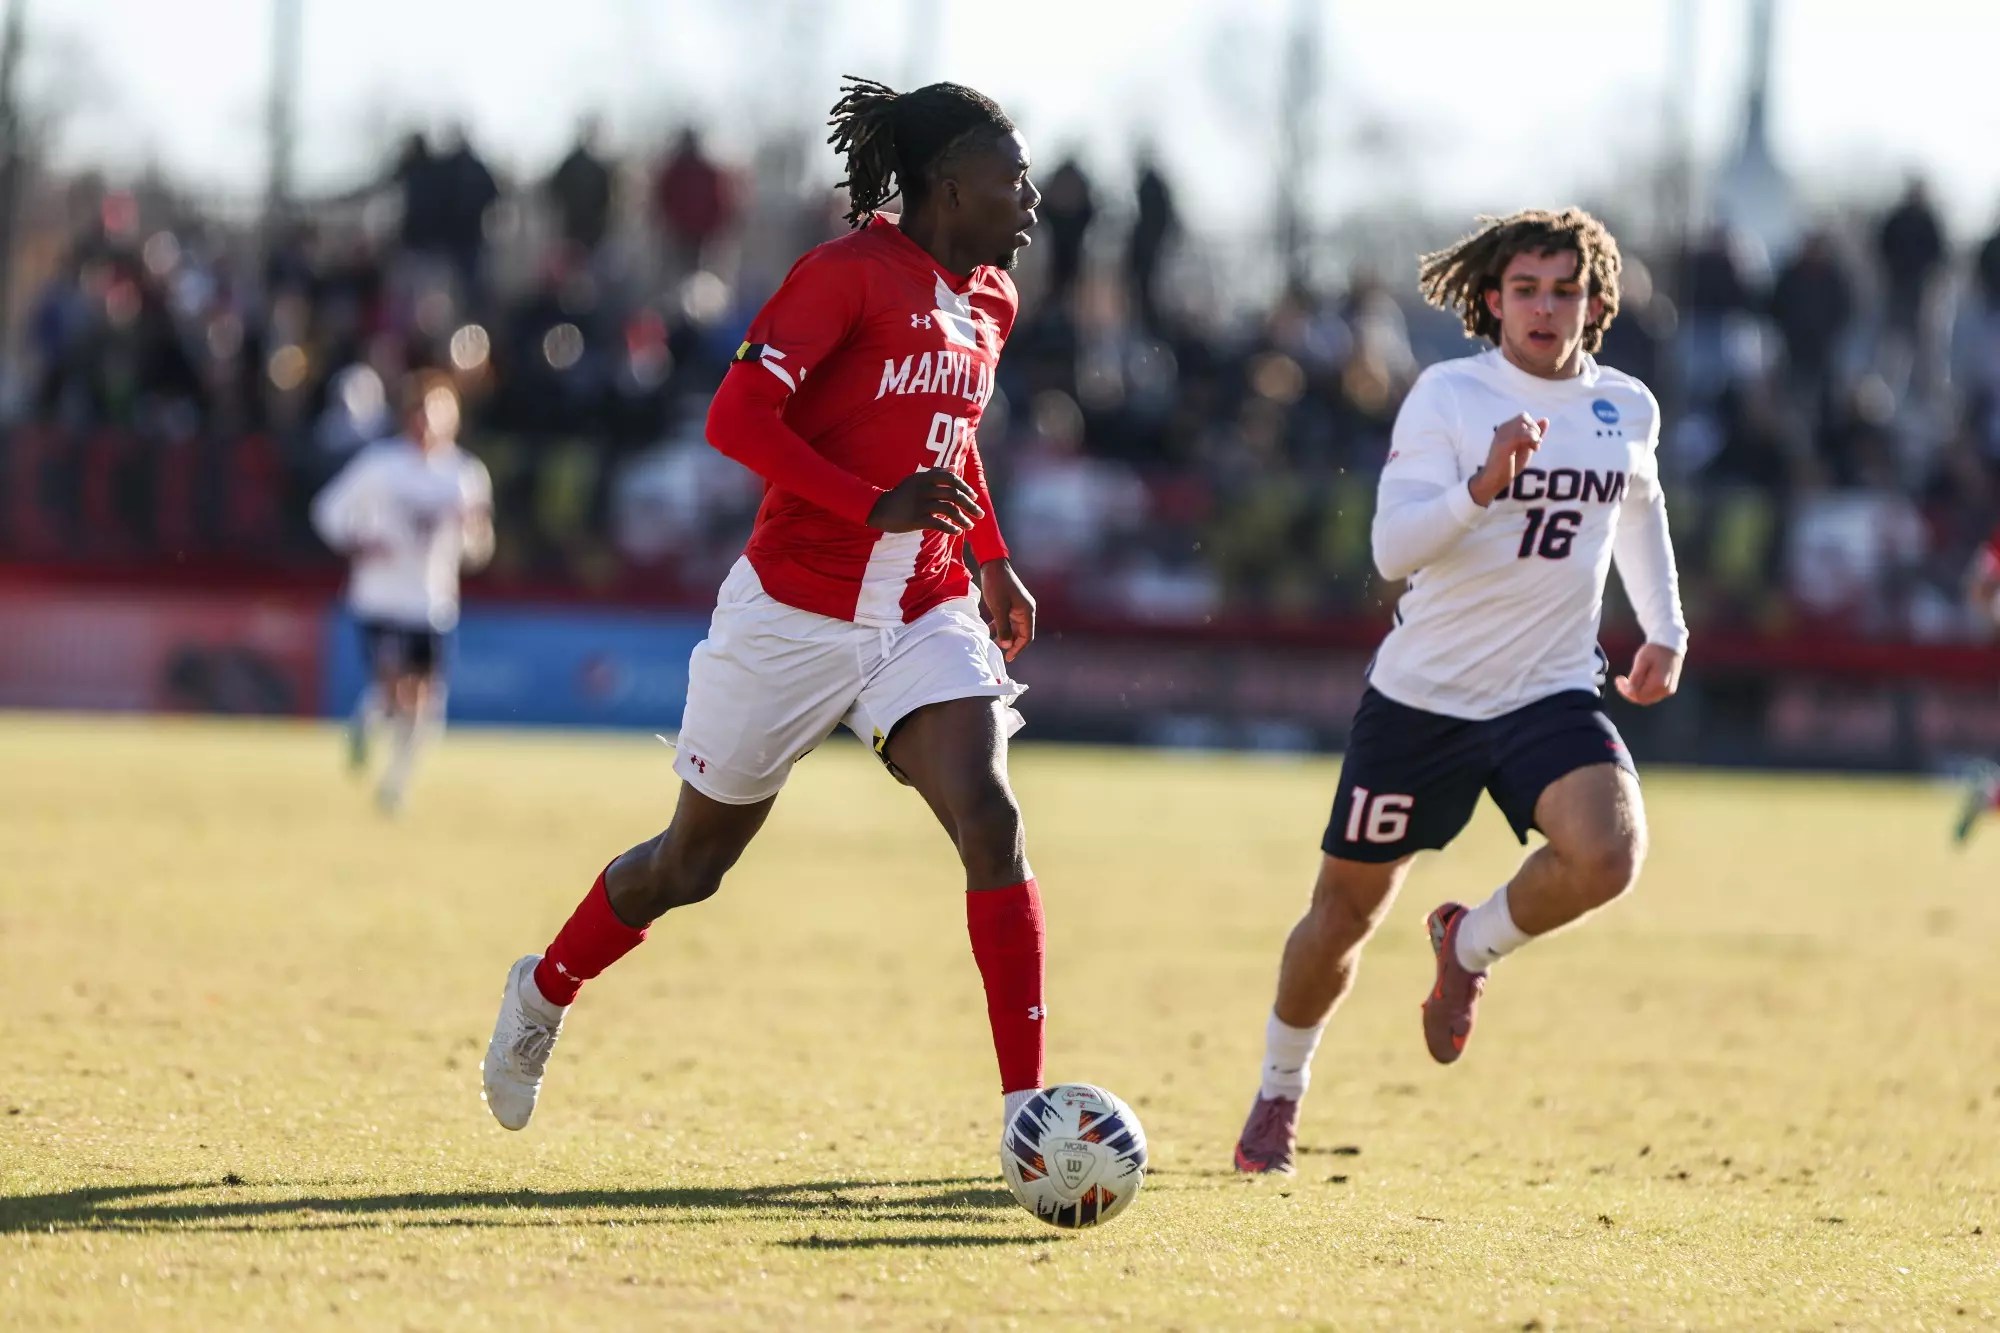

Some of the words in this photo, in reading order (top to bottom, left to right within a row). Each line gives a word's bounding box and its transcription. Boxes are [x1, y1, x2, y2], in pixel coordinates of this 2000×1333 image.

[1477, 466, 1632, 503] CONN
[1517, 507, 1583, 560] 16
[1344, 785, 1414, 844] 16
